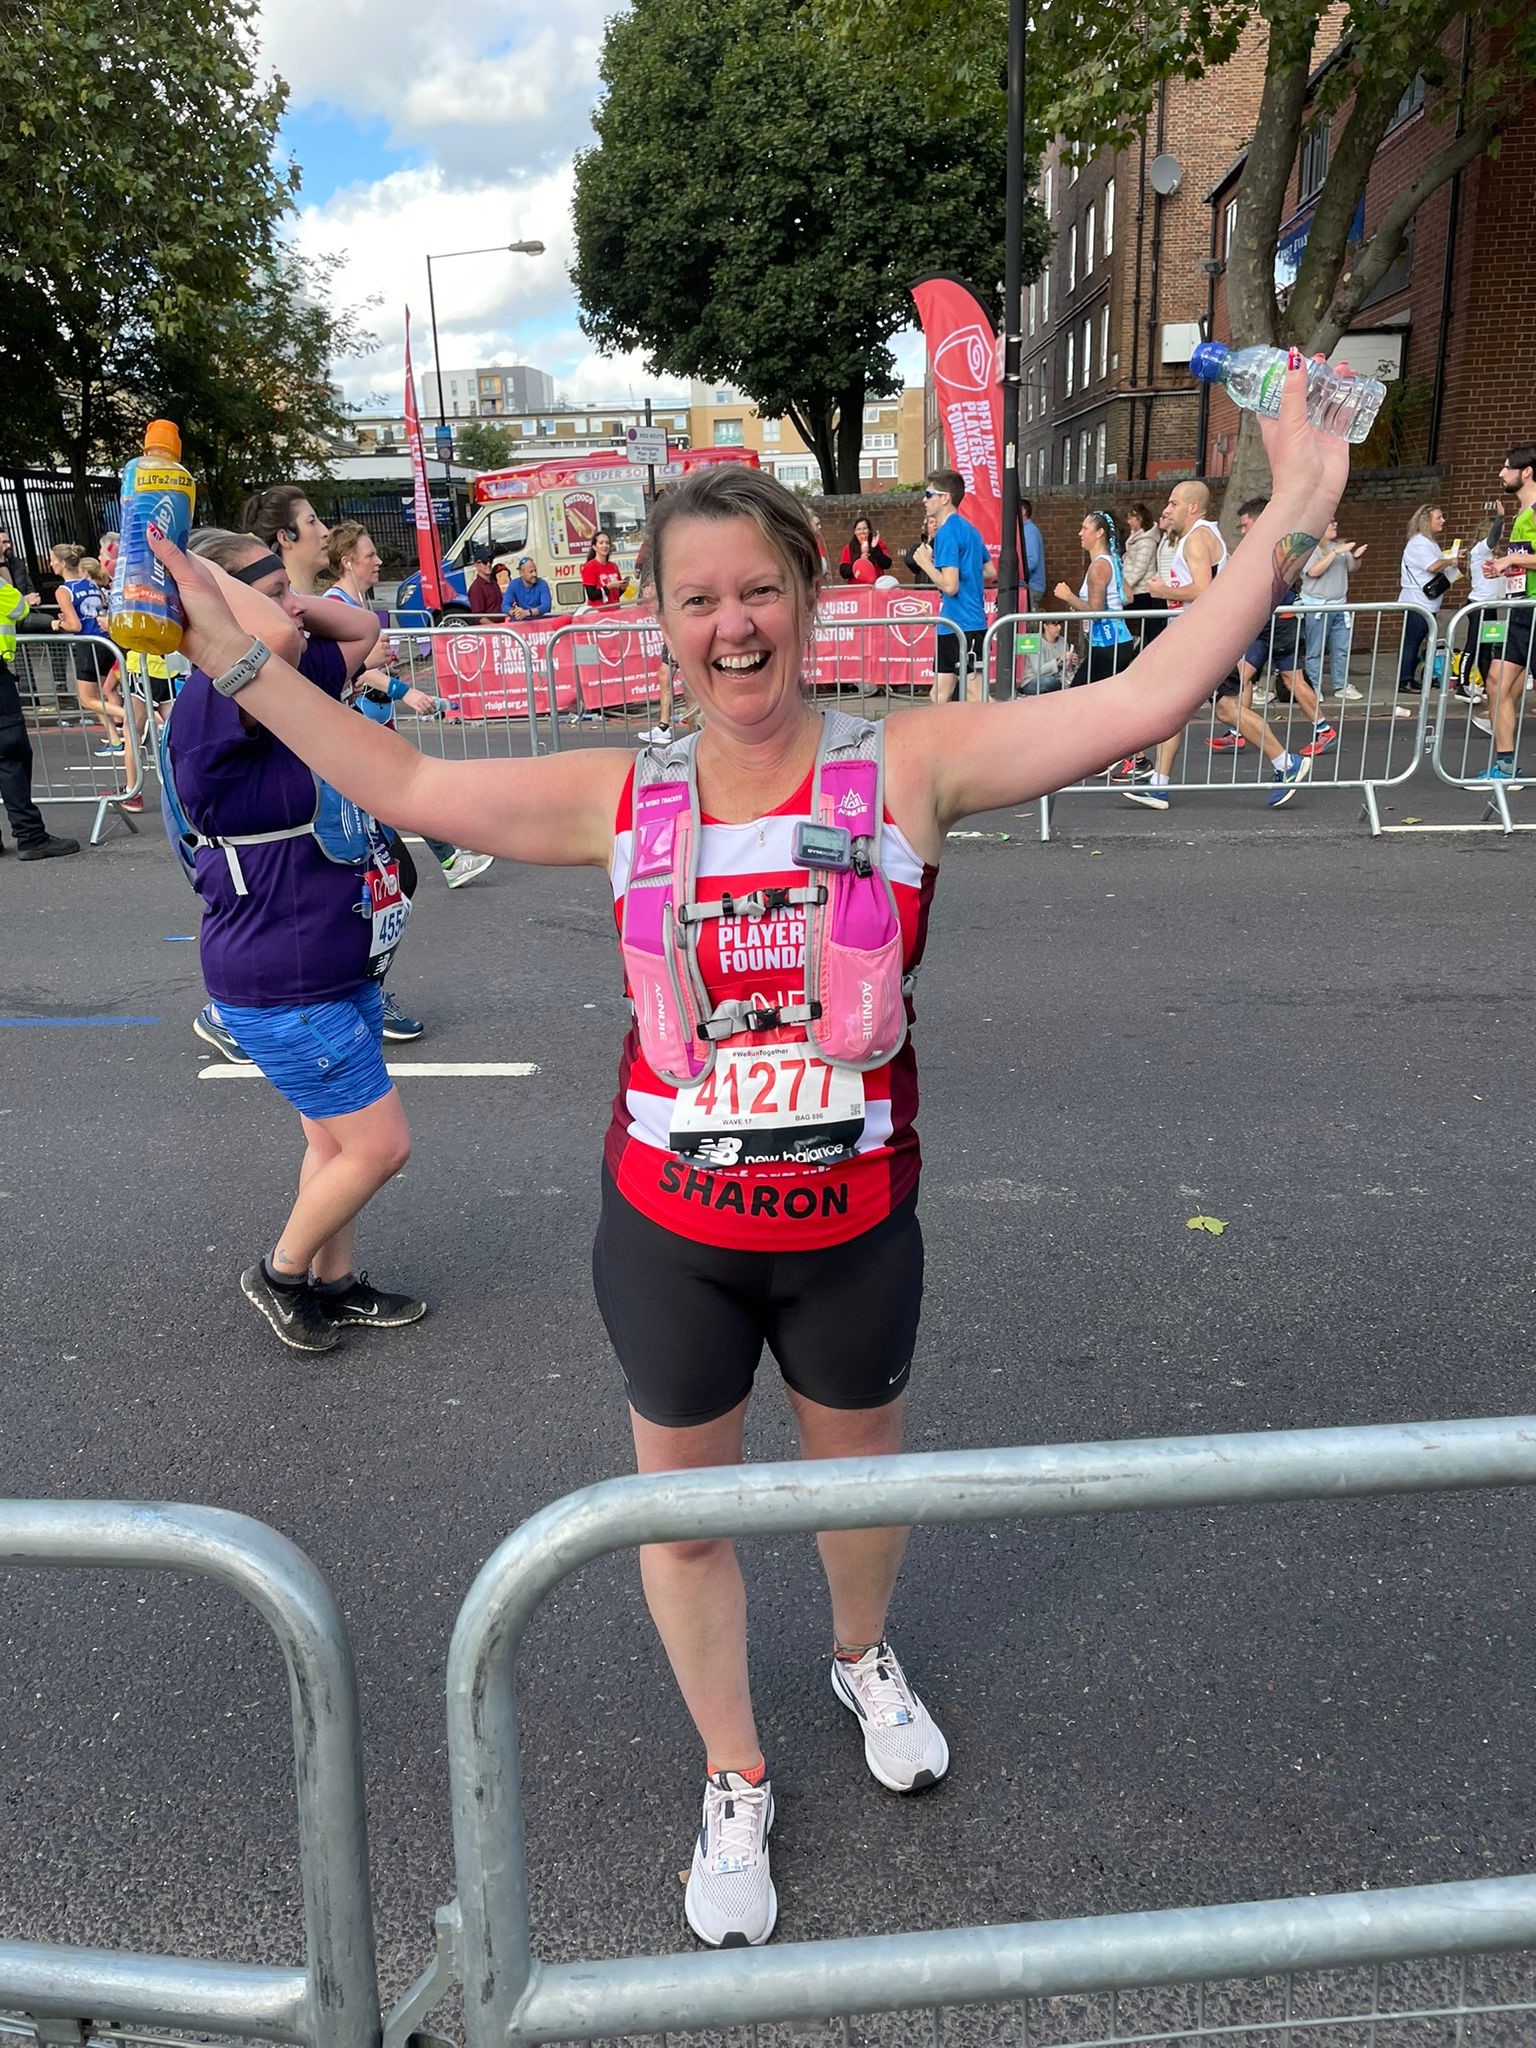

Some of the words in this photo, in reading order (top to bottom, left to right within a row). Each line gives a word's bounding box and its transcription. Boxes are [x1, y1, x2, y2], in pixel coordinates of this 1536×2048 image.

[976, 400, 994, 432] RFU
[962, 401, 987, 467] PLAYERS
[947, 402, 976, 495] FOUNDATION
[585, 470, 621, 483] SUPER
[626, 467, 649, 479] SOF
[658, 465, 677, 475] ICE
[983, 433, 1002, 498] INJURED
[555, 565, 576, 577] HOT
[493, 645, 539, 662] PAYES
[494, 657, 560, 676] FOUNTIN
[485, 700, 529, 711] rfuipf.org.u
[461, 858, 473, 872] N
[718, 922, 805, 950] PLAYER
[719, 949, 807, 973] FOUNDA
[653, 981, 668, 1041] AONIJIE
[860, 980, 874, 1041] AONIJIE
[732, 1048, 789, 1057] #WeRunTogether
[694, 1057, 834, 1115] 41277
[795, 1114, 811, 1122] BAG
[744, 1154, 780, 1164] new
[783, 1142, 843, 1163] balance
[658, 1161, 850, 1219] SHARON
